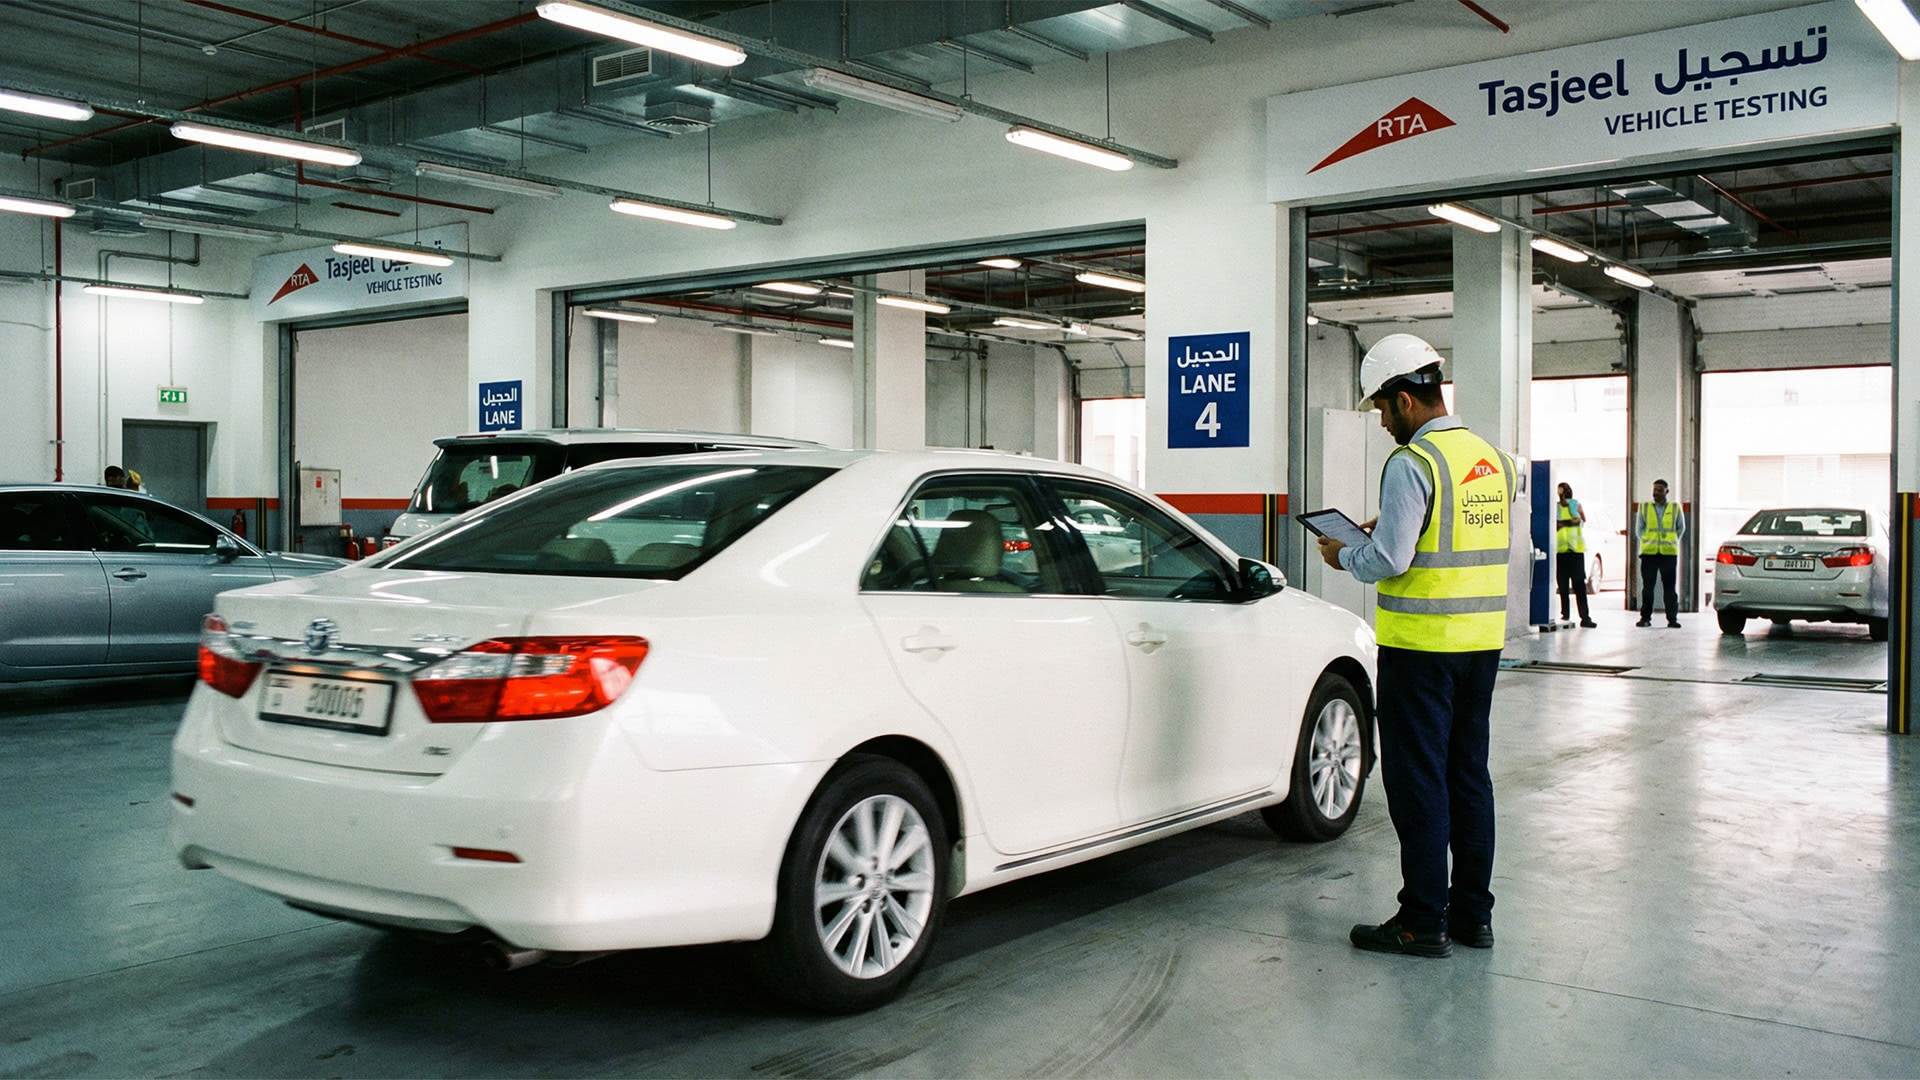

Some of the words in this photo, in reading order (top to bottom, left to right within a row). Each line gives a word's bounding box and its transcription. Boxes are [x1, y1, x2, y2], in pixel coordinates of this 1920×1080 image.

[1654, 25, 1828, 95] تسجيل
[1478, 58, 1629, 118] Tasjeel
[1604, 103, 1708, 136] VEHICLE
[1714, 86, 1828, 121] TESTING
[1377, 113, 1428, 138] RTA
[290, 273, 310, 287] RTA
[324, 255, 375, 281] Tasjeel
[366, 278, 402, 295] VEHICLE
[403, 272, 443, 290] TESTING
[1177, 342, 1240, 369] الحجيل
[1180, 372, 1237, 395] LANE
[482, 387, 518, 407] الحجيل
[485, 410, 516, 425] LANE
[1194, 401, 1222, 438] 4
[1461, 508, 1504, 529] Tasjeel
